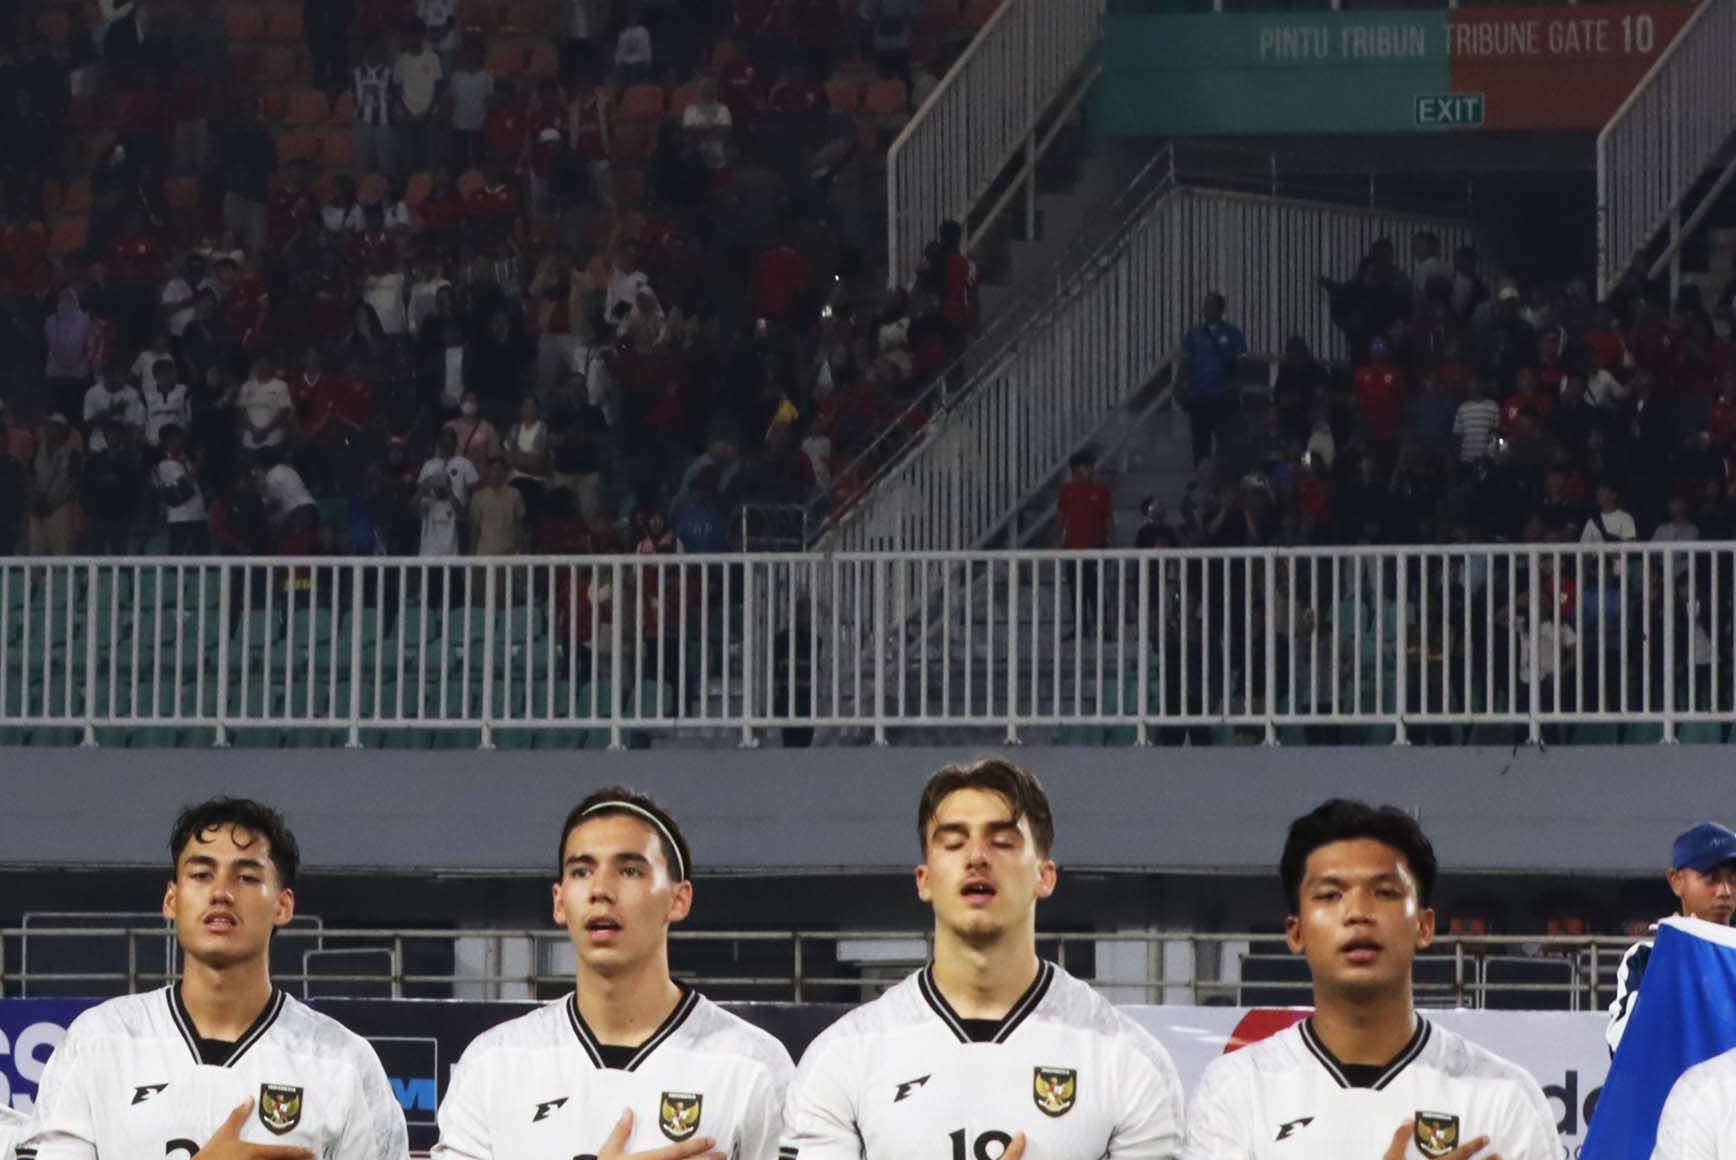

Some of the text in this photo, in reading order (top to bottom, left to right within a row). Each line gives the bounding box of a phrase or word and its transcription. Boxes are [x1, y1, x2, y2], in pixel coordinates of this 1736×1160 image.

[1259, 14, 1655, 58] PINTU TRIBUN TRIBUNE GATE 10
[1418, 99, 1481, 122] EXIT
